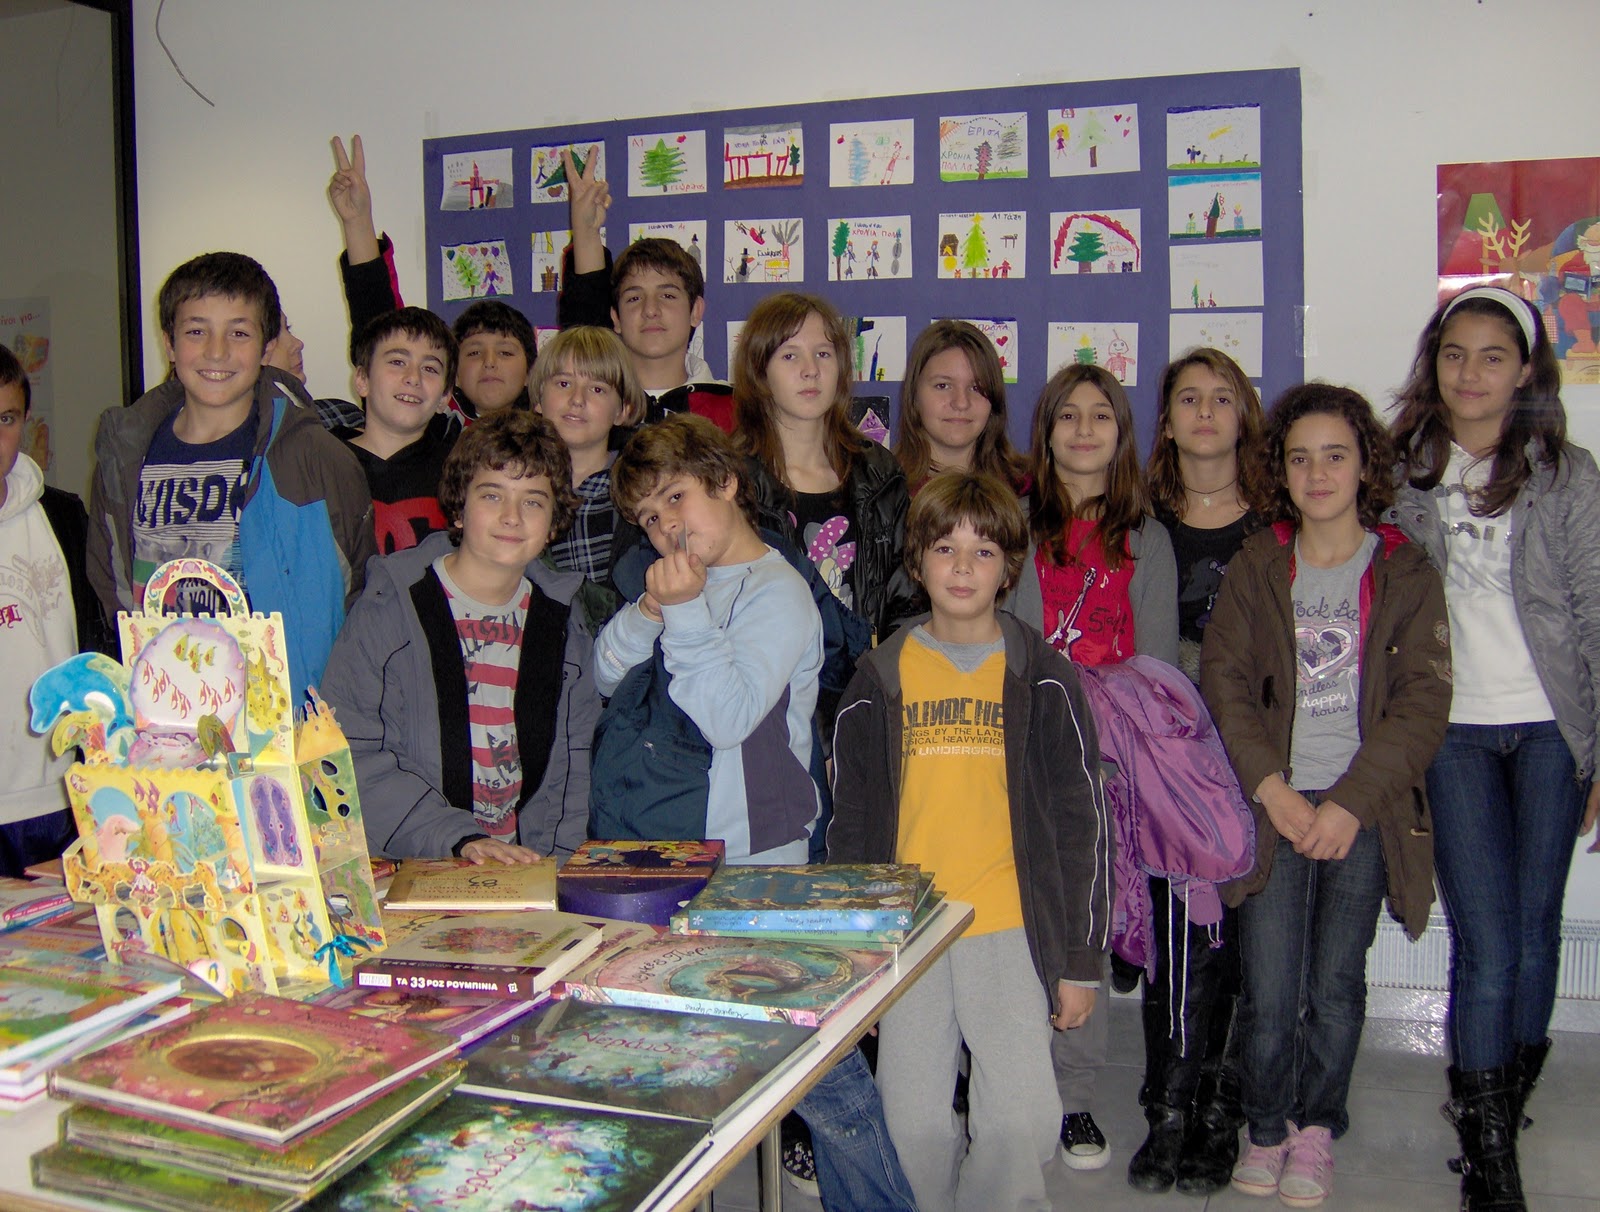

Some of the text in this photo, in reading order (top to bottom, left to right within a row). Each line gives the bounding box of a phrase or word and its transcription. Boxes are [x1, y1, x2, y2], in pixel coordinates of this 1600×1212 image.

[1301, 692, 1347, 708] happy
[1311, 704, 1349, 718] hours
[934, 727, 947, 736] BY
[953, 727, 972, 736] THE
[396, 977, 408, 986] ΤΑ
[410, 976, 426, 989] 33
[426, 979, 445, 988] ΡΟΖ
[446, 980, 498, 991] ΡΟΥΜΠΙΝΙΑ
